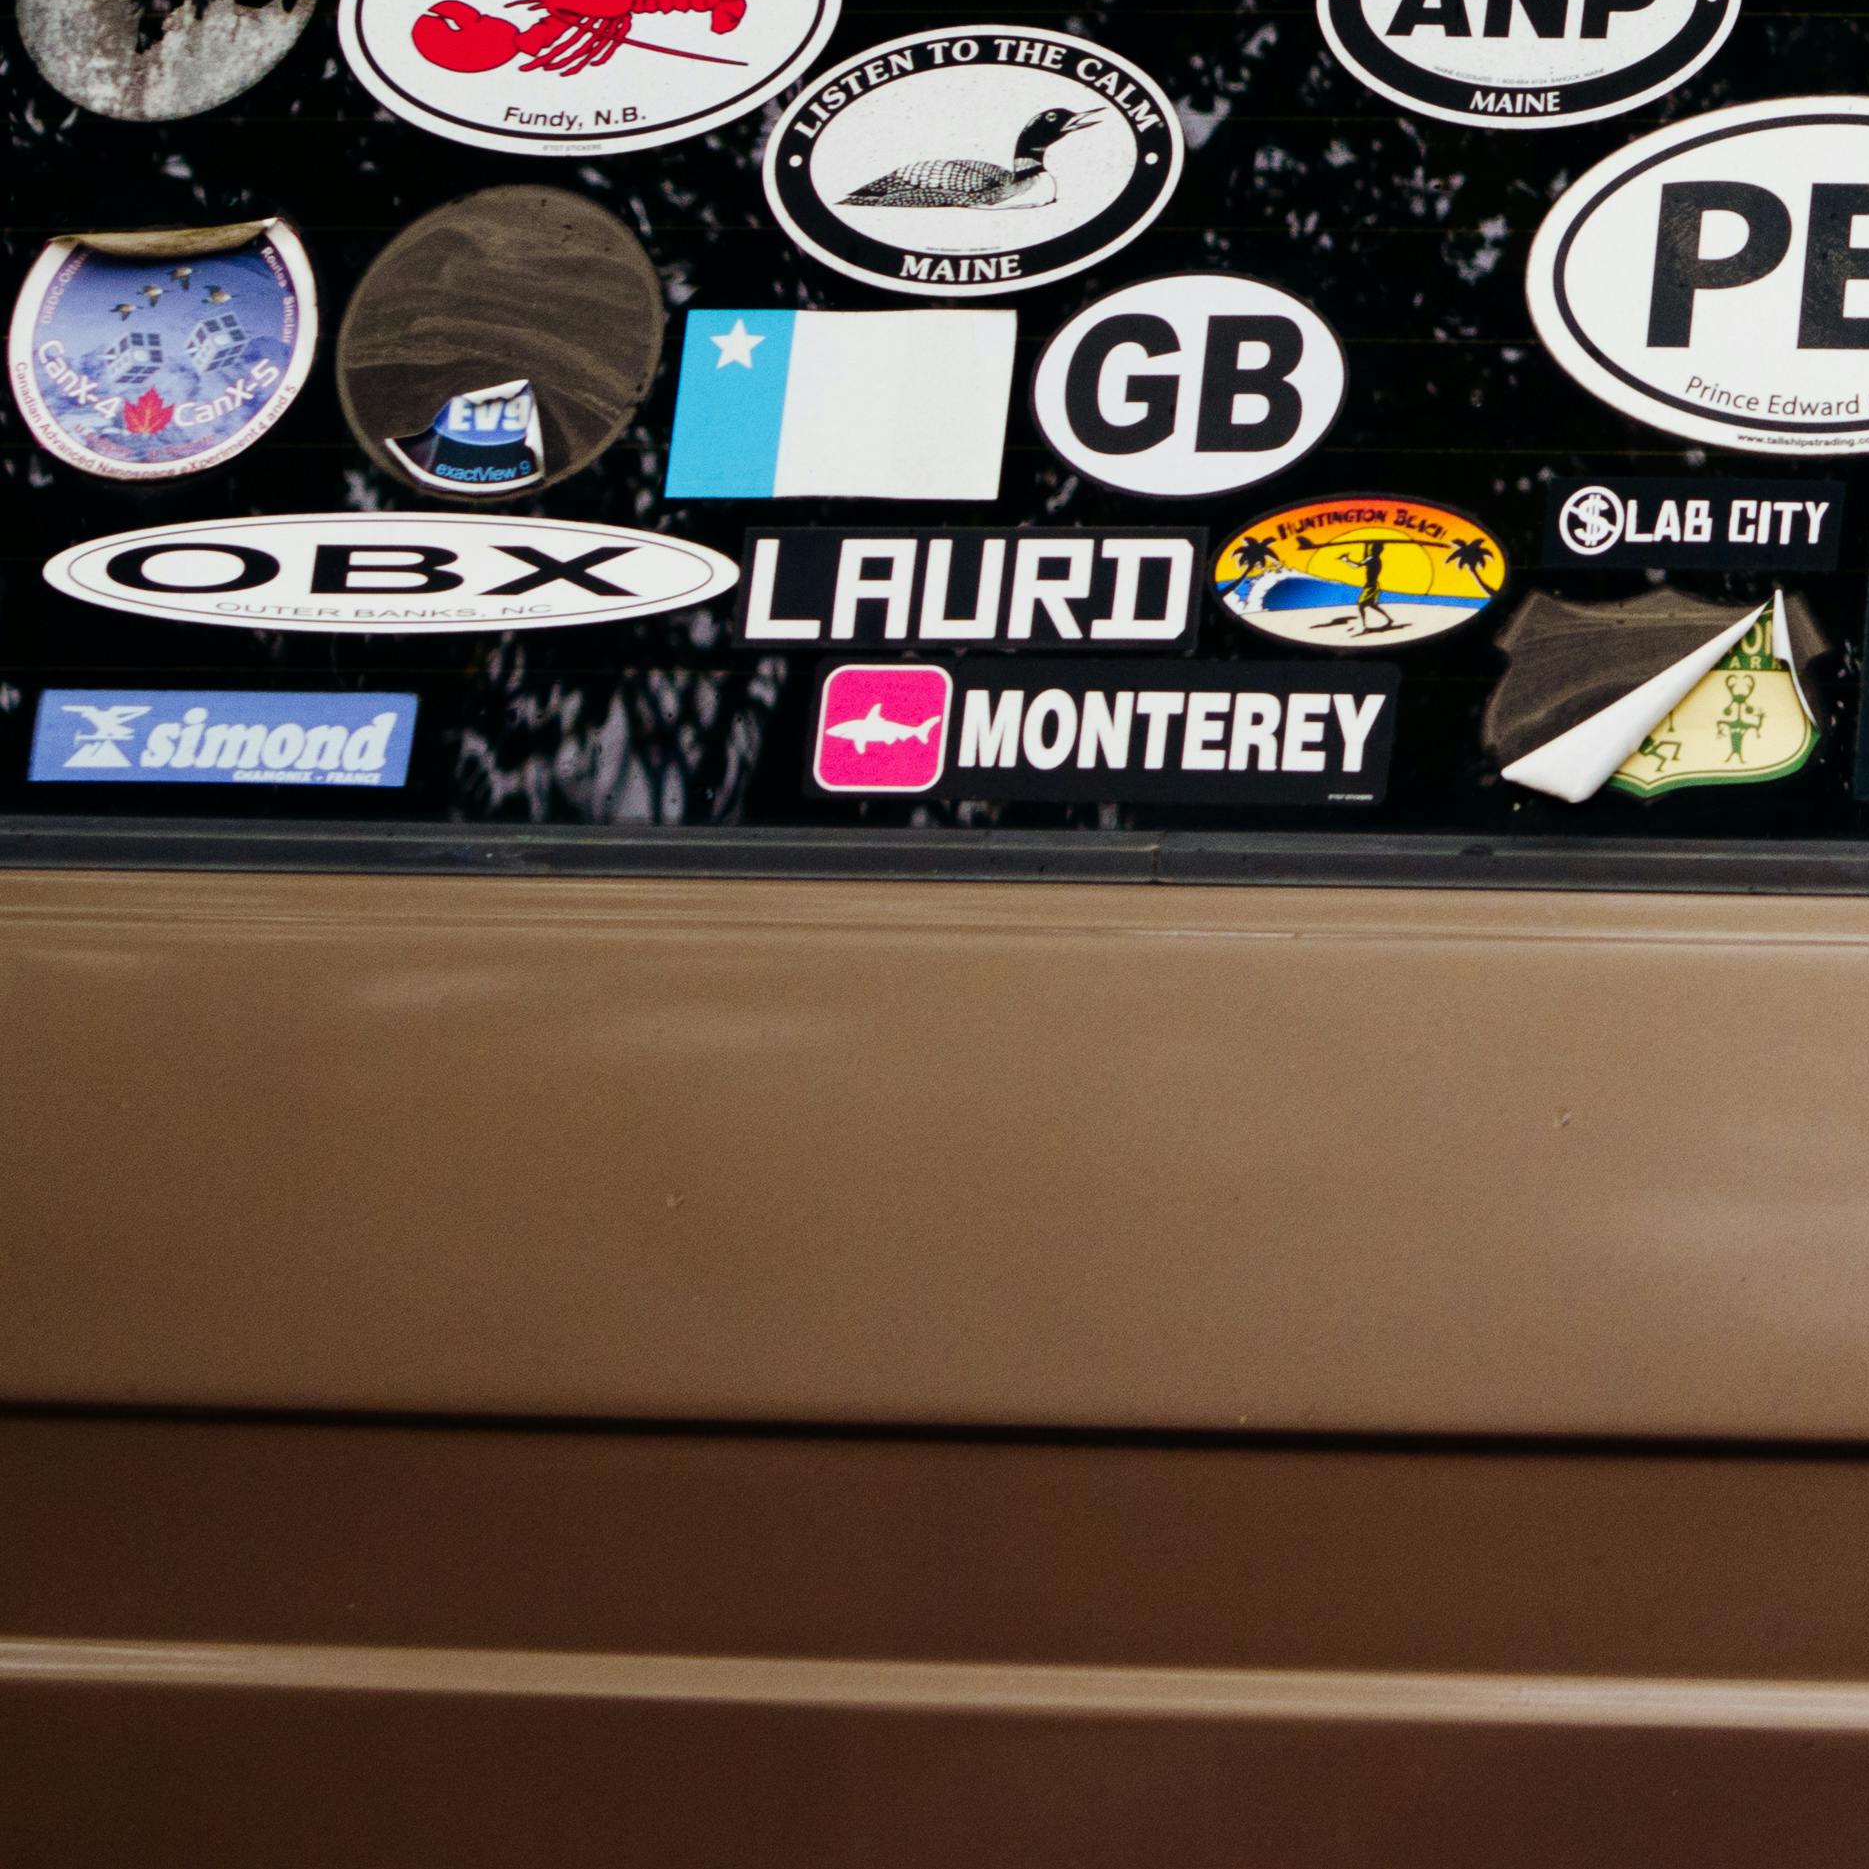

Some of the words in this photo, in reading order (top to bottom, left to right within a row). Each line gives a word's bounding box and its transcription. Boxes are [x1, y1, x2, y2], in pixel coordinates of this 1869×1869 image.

[794, 48, 914, 140] LISTEN
[926, 38, 980, 66] TO
[994, 38, 1068, 70] THE
[1075, 57, 1162, 133] CALM
[1469, 90, 1561, 114] MAINE
[503, 106, 583, 131] Fundy,
[594, 106, 646, 126] N.B.
[900, 254, 1022, 282] MAINE
[15, 361, 42, 426] Canadian
[38, 339, 123, 420] CanX-4
[173, 358, 281, 428] CanX-5
[1064, 312, 1304, 455] GB
[1684, 375, 1760, 411] Prince
[1767, 393, 1860, 417] Edward
[448, 395, 531, 431] EV9
[435, 463, 518, 482] exactView
[1277, 508, 1388, 541] HUNTINGTON
[1393, 508, 1449, 541] BEACH
[1728, 500, 1830, 545] CITY
[105, 542, 645, 598] OBX
[215, 600, 340, 618] OUTER
[501, 603, 554, 616] NC
[140, 707, 398, 772] simond
[958, 687, 1387, 773] MONTEREY
[232, 770, 313, 783] CHAMONIX
[324, 771, 382, 785] FRANCE
